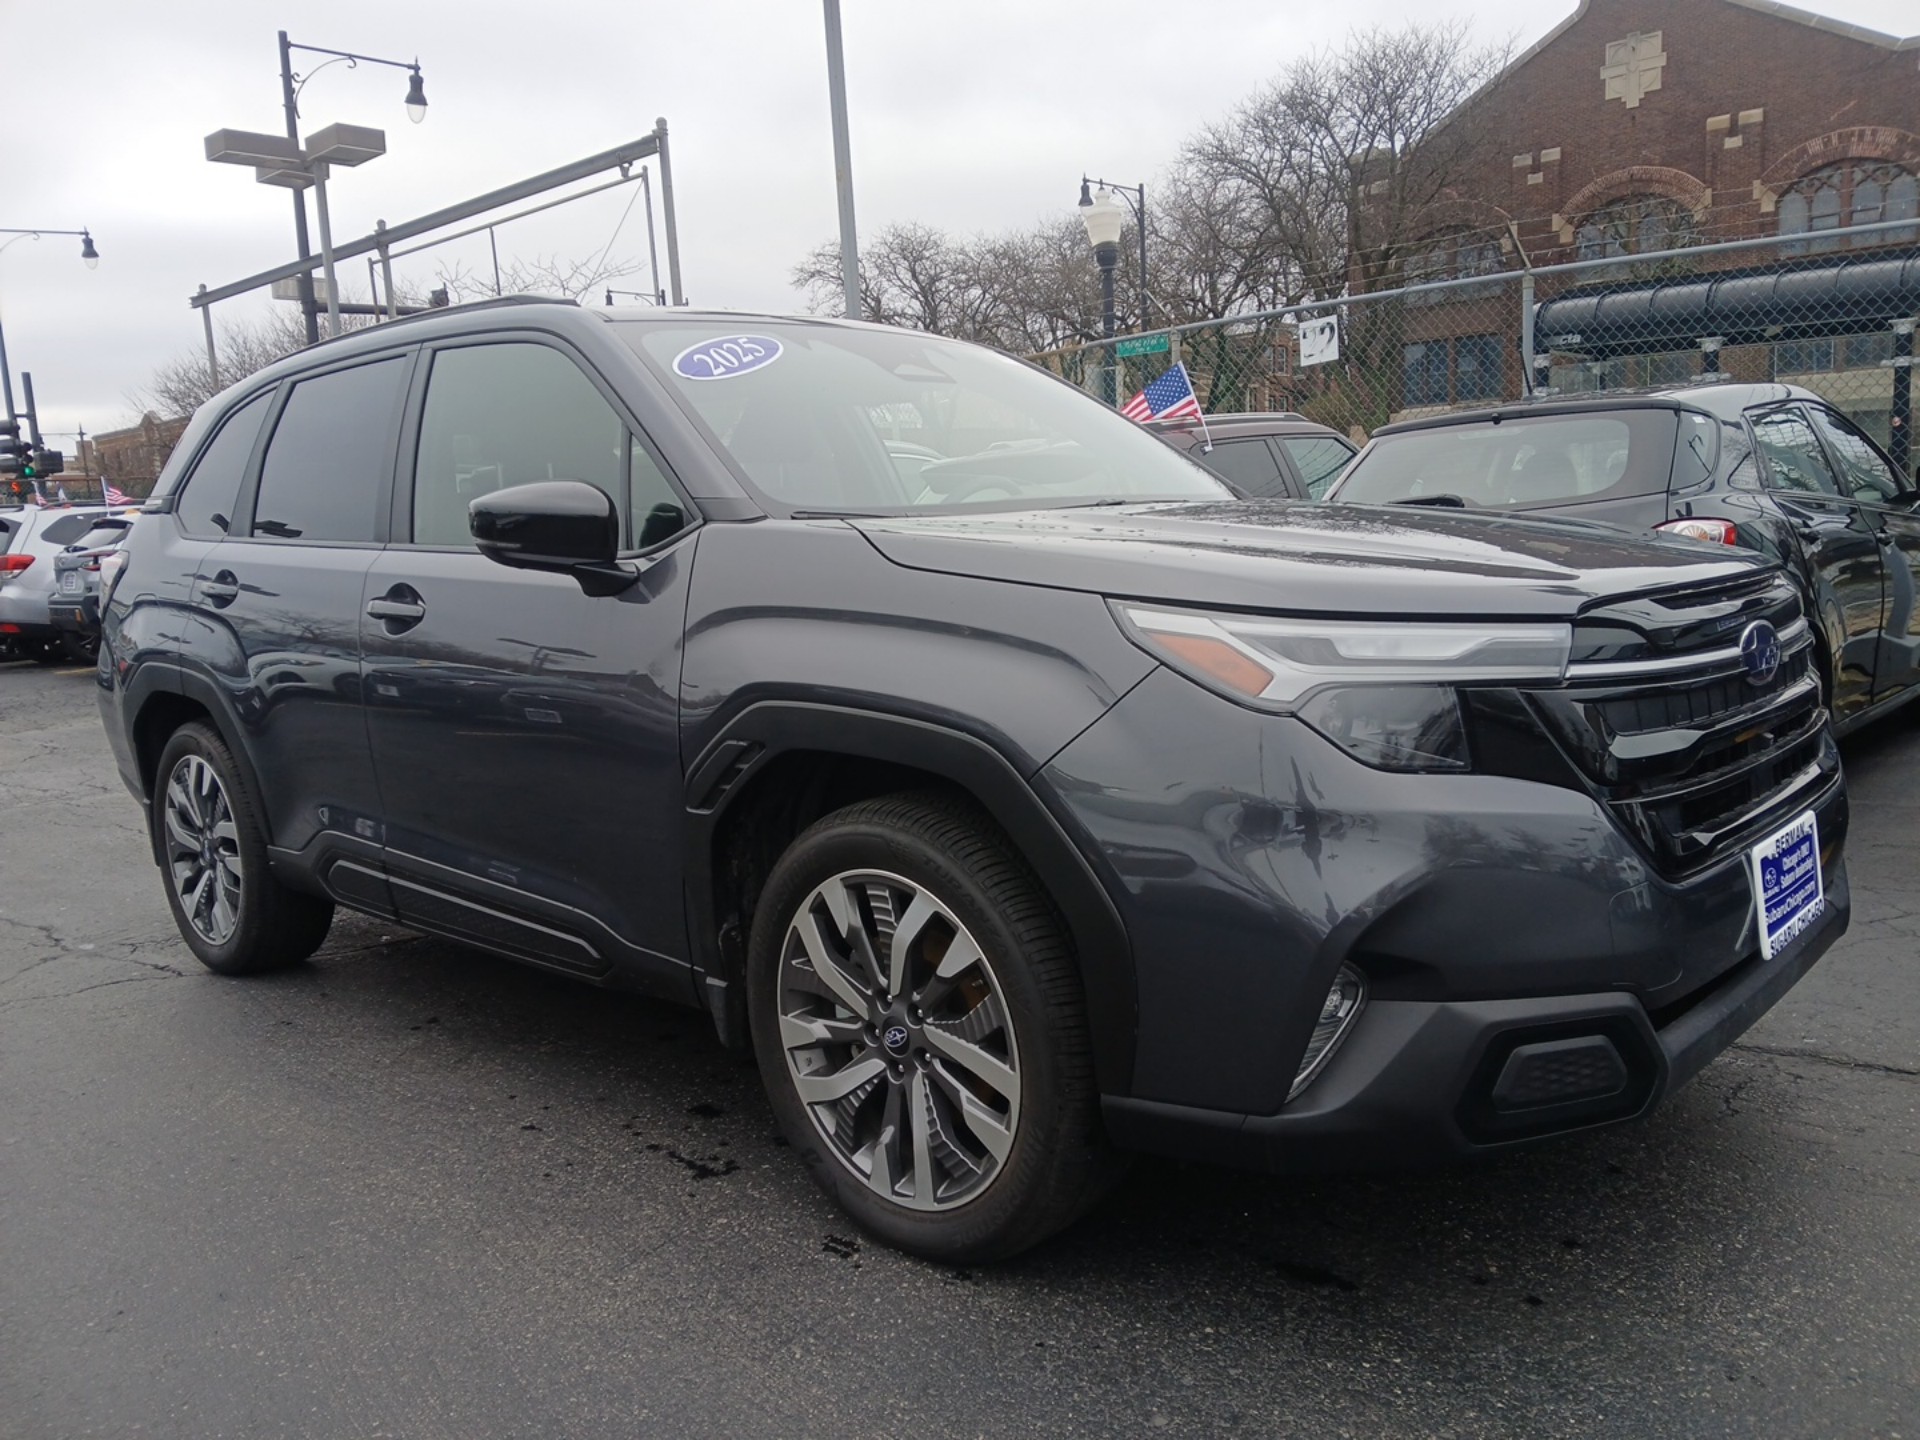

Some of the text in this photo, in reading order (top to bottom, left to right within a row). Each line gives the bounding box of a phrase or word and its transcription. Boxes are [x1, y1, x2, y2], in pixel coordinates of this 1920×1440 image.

[692, 337, 765, 376] 2025
[1775, 822, 1806, 854] BERMAN
[1770, 897, 1825, 958] SUBARU CHICAGO
